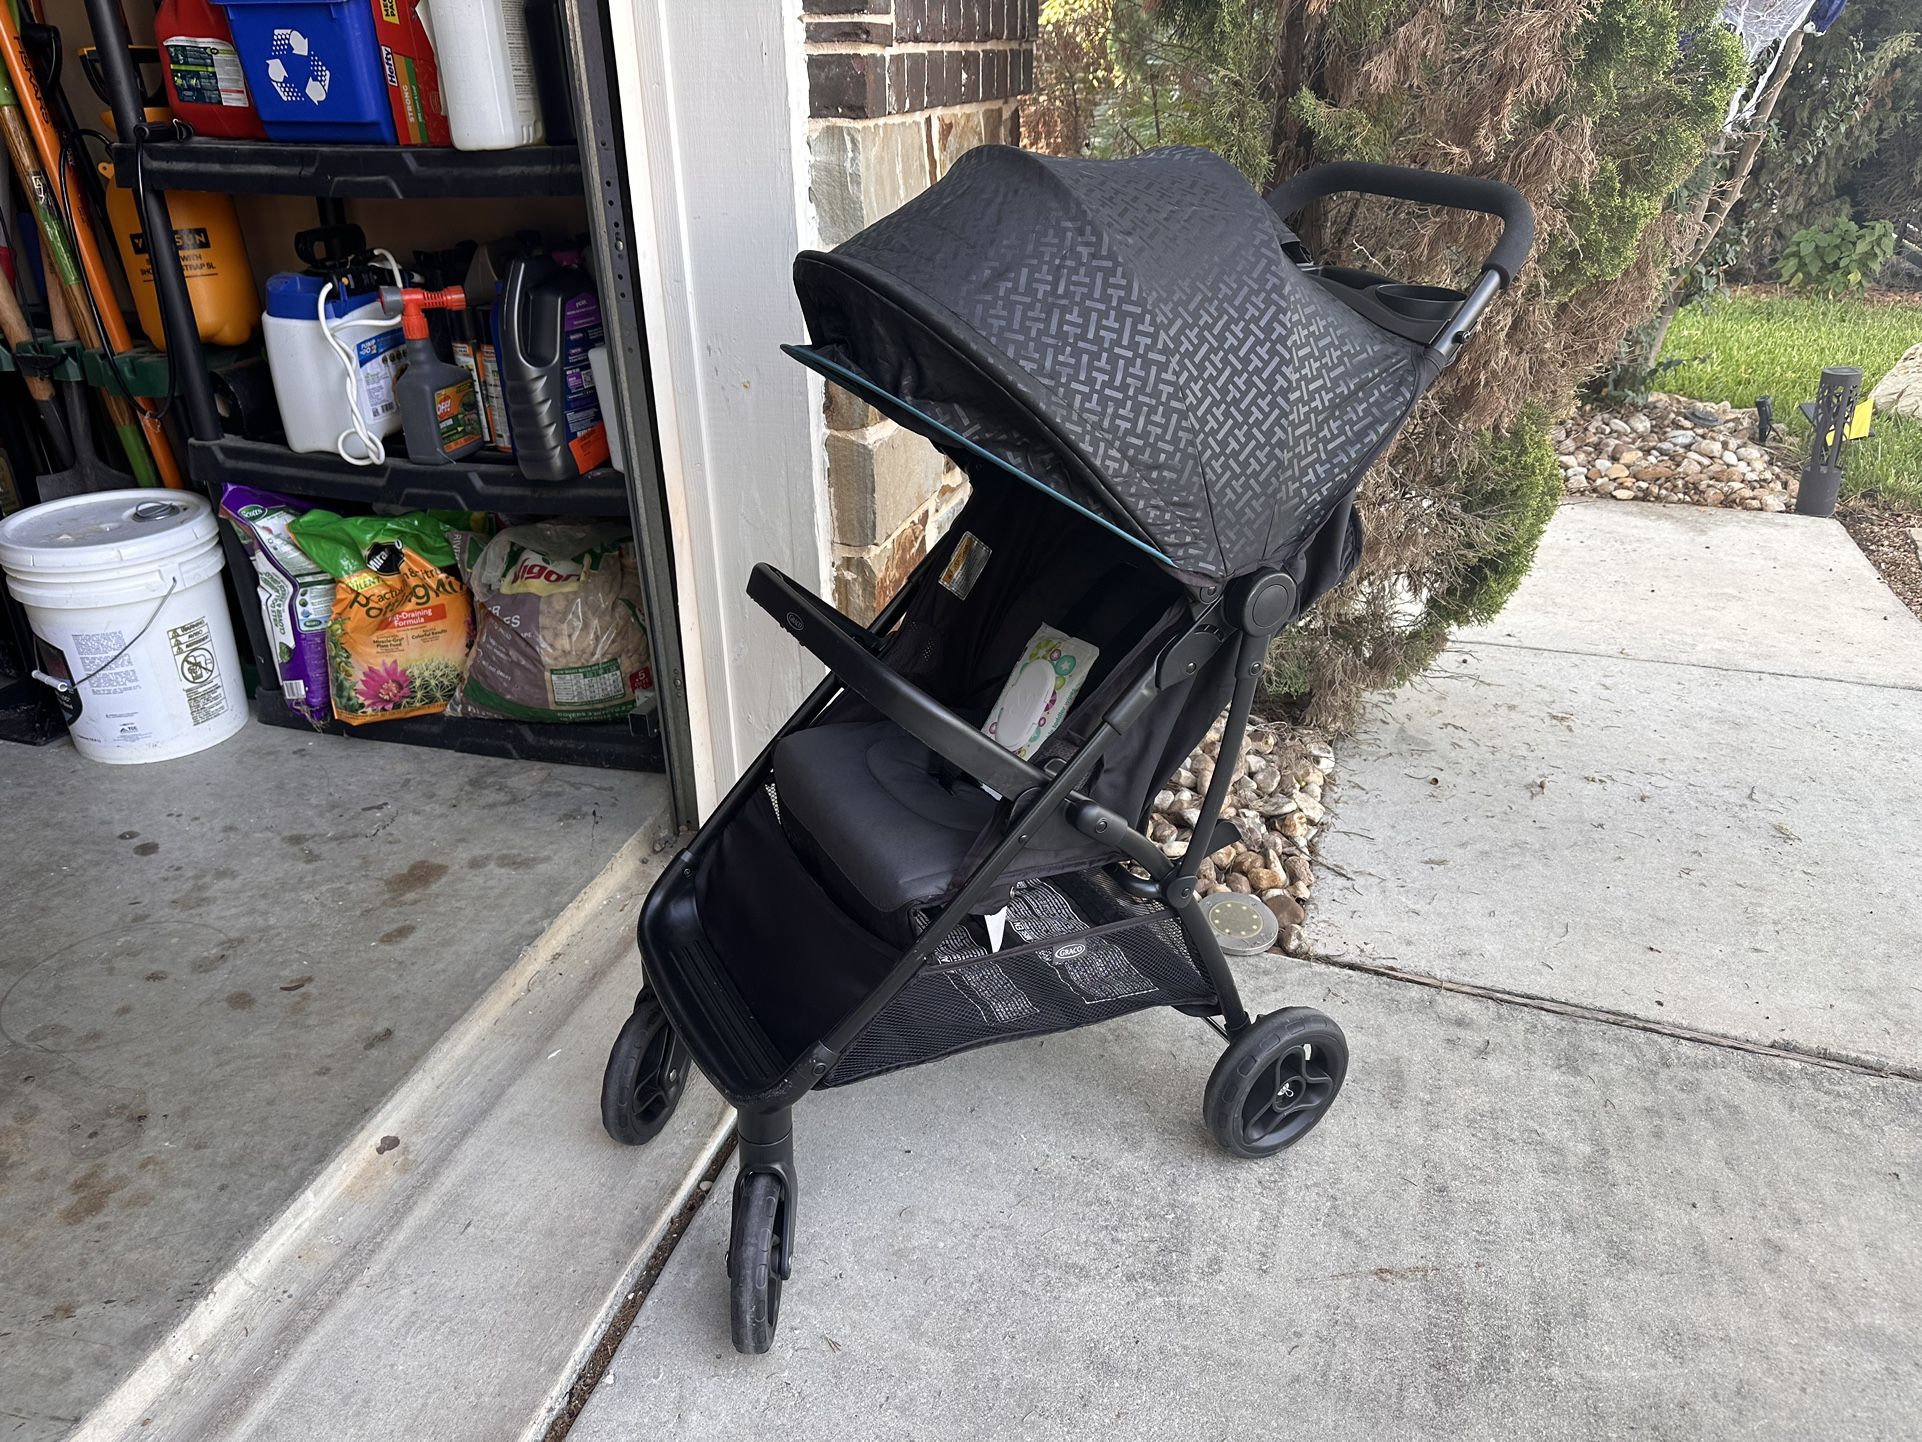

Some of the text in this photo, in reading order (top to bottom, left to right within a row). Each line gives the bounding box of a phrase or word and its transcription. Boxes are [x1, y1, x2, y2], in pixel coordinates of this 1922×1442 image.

[384, 48, 396, 84] Hefty
[13, 36, 50, 124] FISKARS
[402, 85, 415, 123] STRONG
[183, 263, 205, 272] TRAP
[240, 507, 263, 518] Scotts
[394, 617, 425, 627] Formula
[1051, 706, 1066, 729] toddler
[1059, 945, 1084, 957] GRACO
